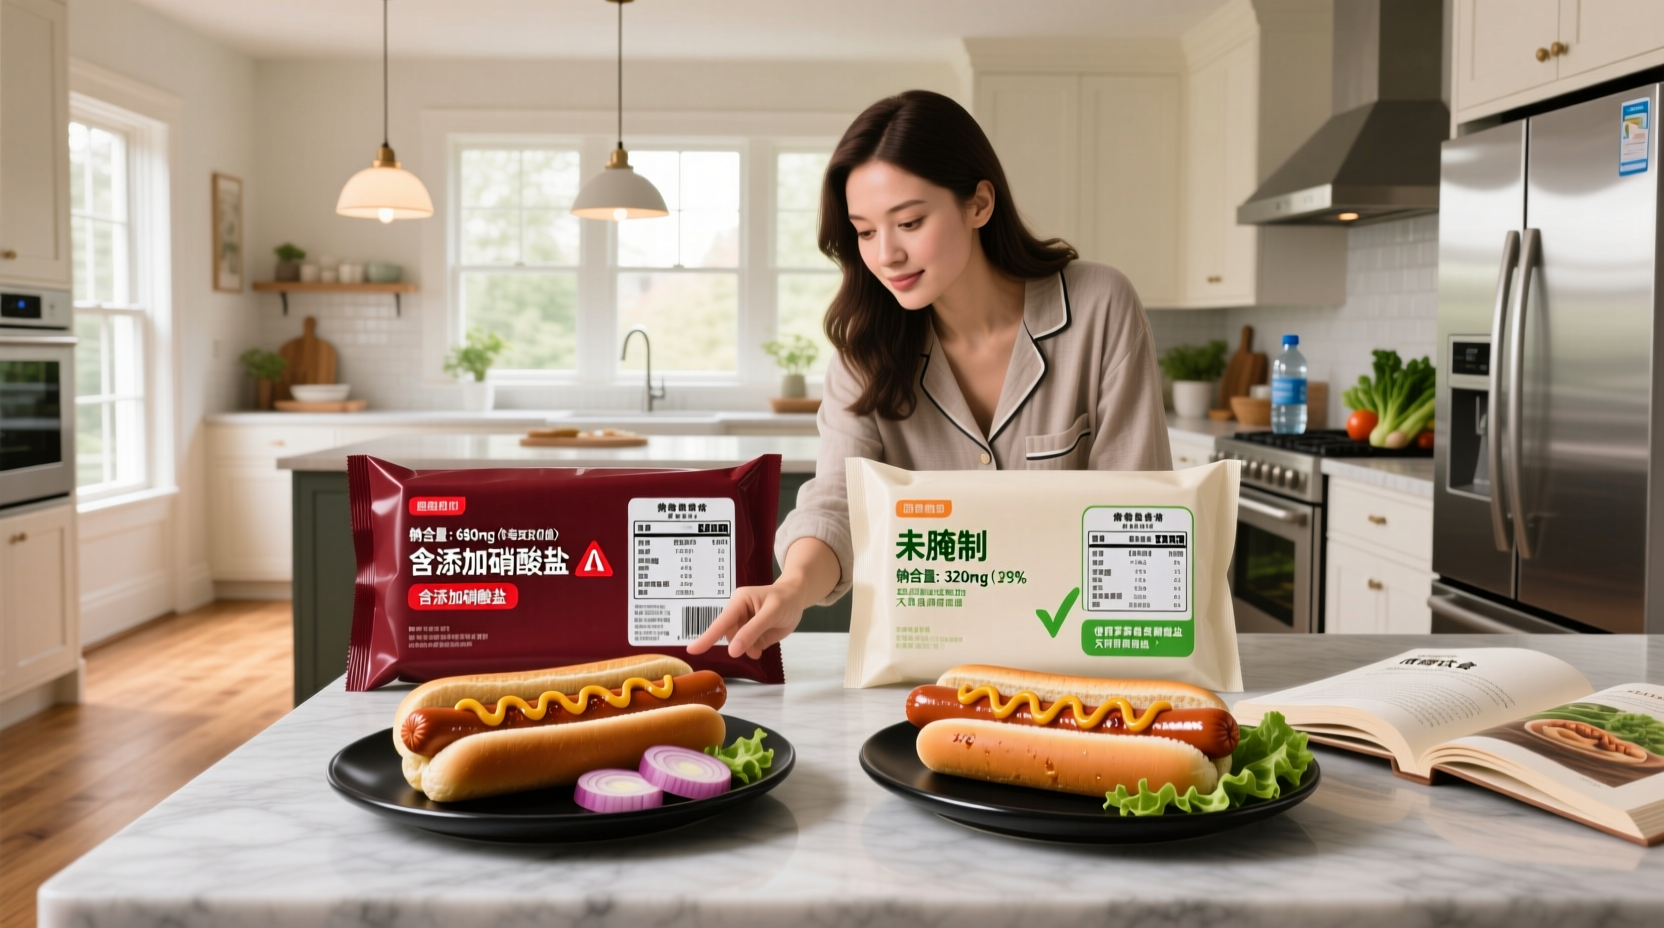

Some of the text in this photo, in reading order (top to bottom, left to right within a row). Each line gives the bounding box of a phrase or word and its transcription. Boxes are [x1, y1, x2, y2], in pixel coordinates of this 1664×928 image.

[409, 546, 570, 576] 含添加硝酸盐
[895, 528, 987, 562] 未腌制
